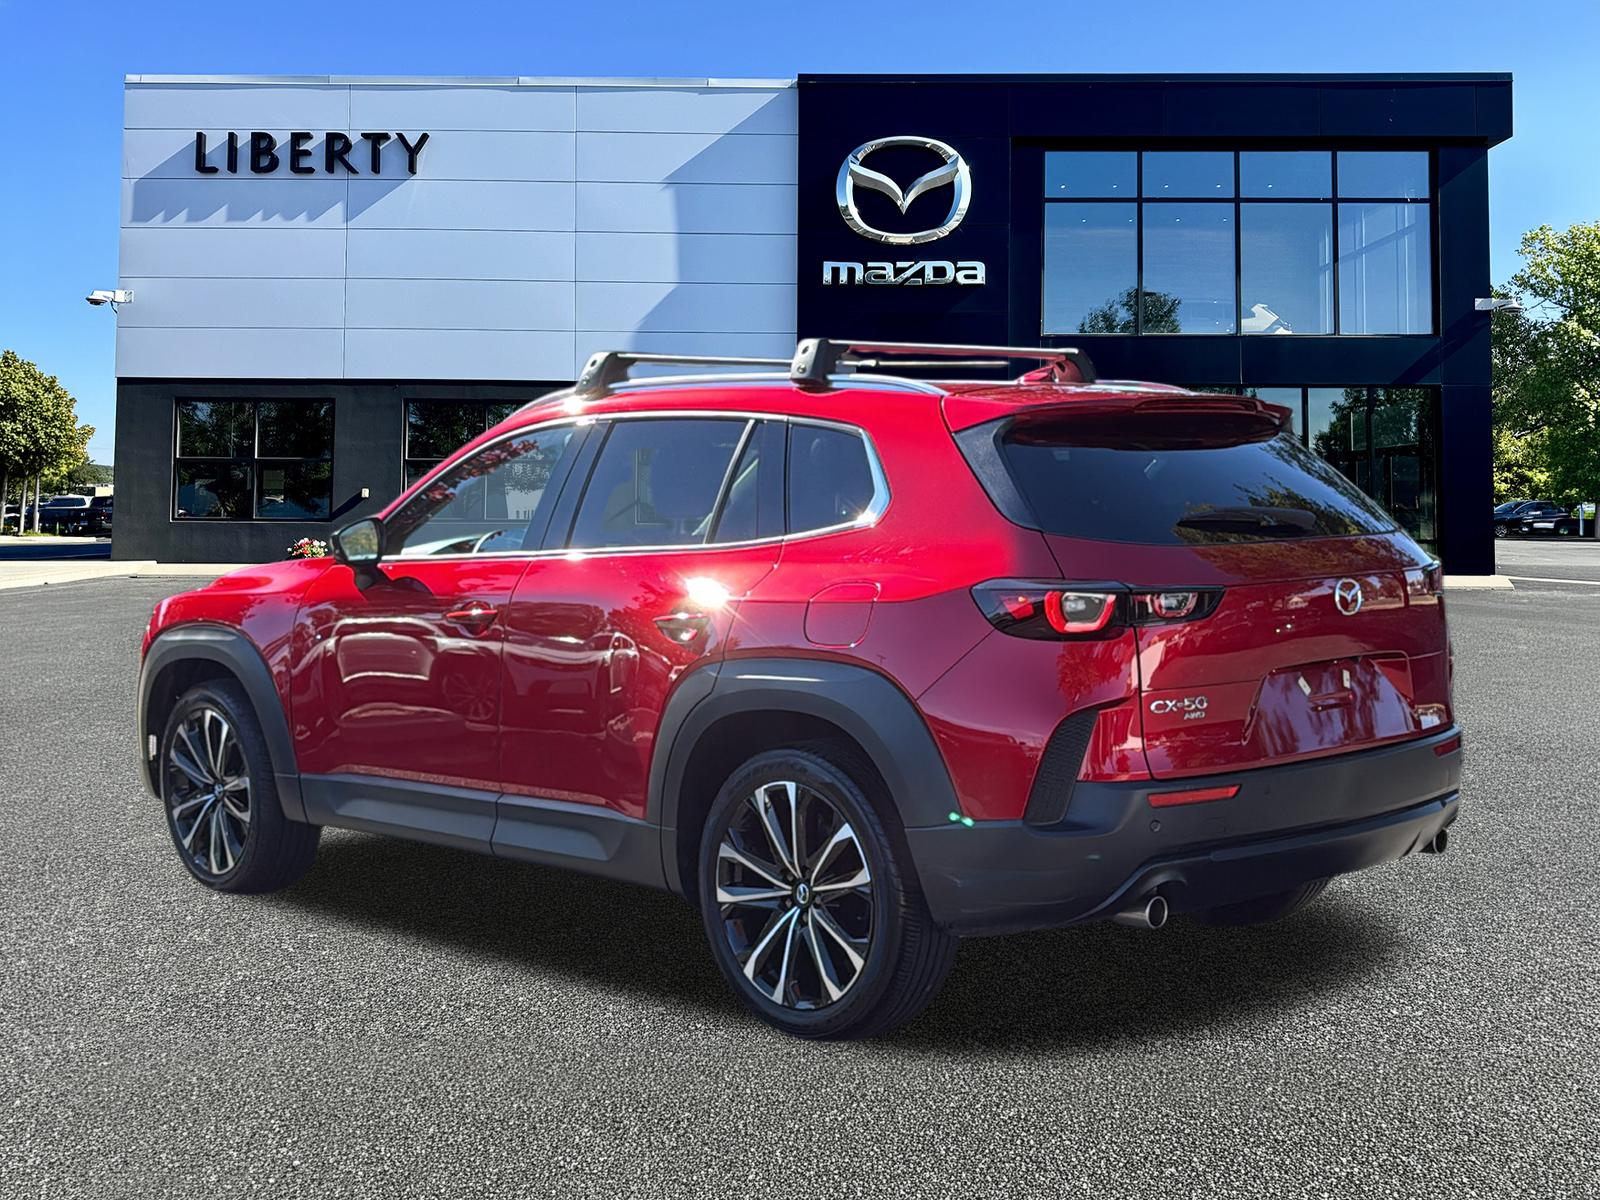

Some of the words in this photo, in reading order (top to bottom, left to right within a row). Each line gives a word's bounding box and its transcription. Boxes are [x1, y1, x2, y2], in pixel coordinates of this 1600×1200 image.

[195, 131, 430, 175] LIBERTY
[1150, 696, 1209, 714] CX-50
[1183, 711, 1206, 721] AWD
